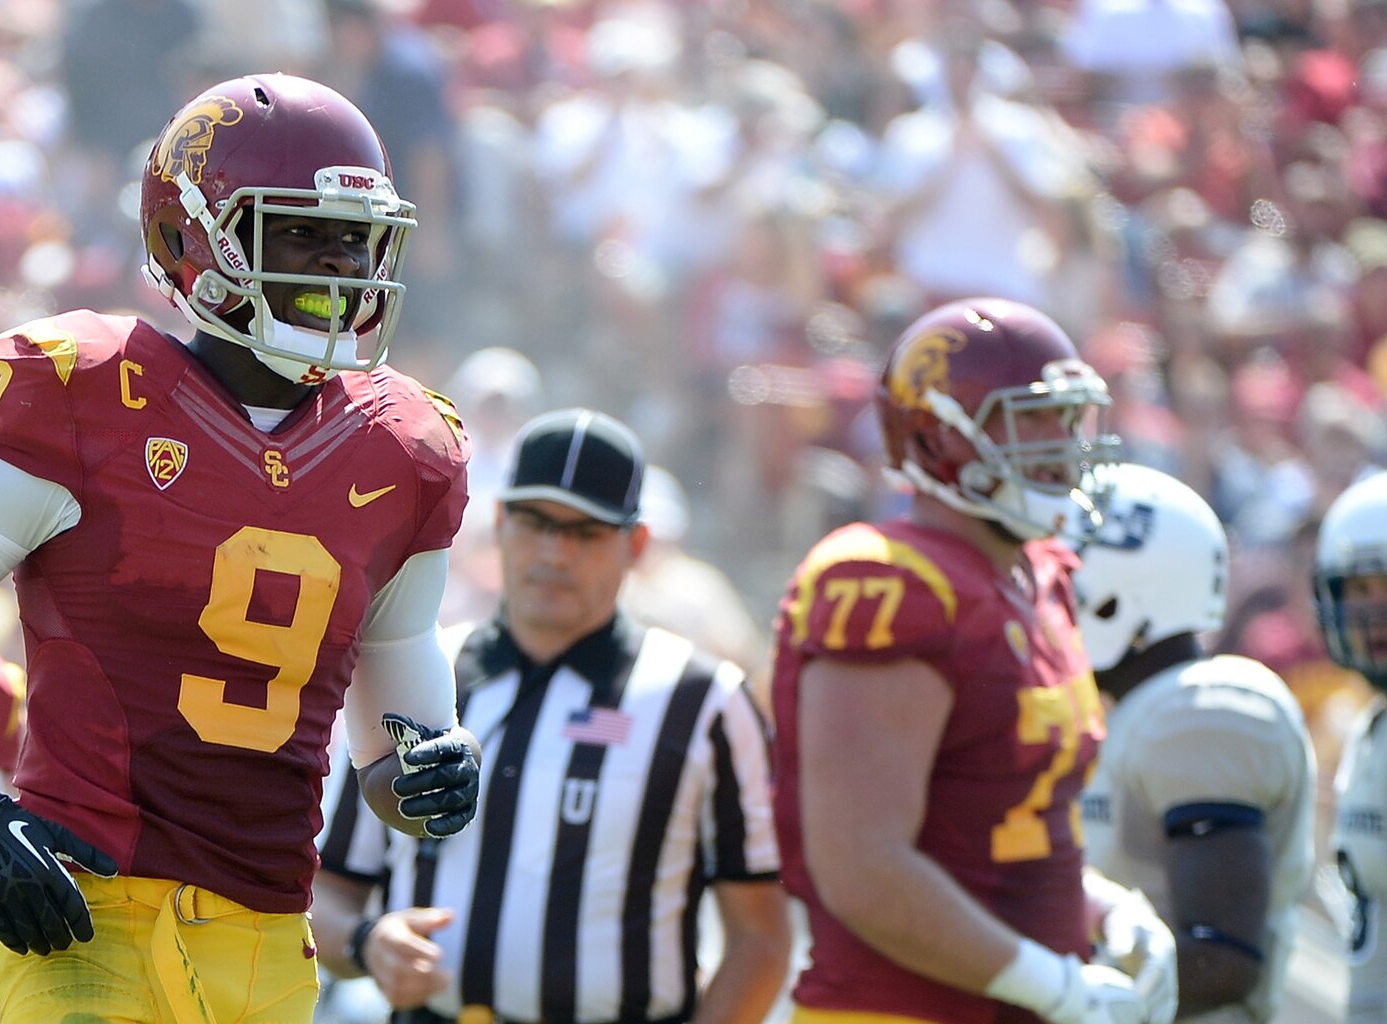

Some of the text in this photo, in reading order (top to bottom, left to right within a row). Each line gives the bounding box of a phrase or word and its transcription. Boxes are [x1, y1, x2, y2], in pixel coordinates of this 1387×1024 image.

[338, 173, 375, 190] USC
[119, 359, 147, 410] C
[149, 439, 187, 473] PAC
[154, 459, 175, 481] 12
[264, 450, 289, 488] SC
[823, 575, 905, 650] 77
[177, 525, 342, 753] 9
[562, 777, 596, 825] U
